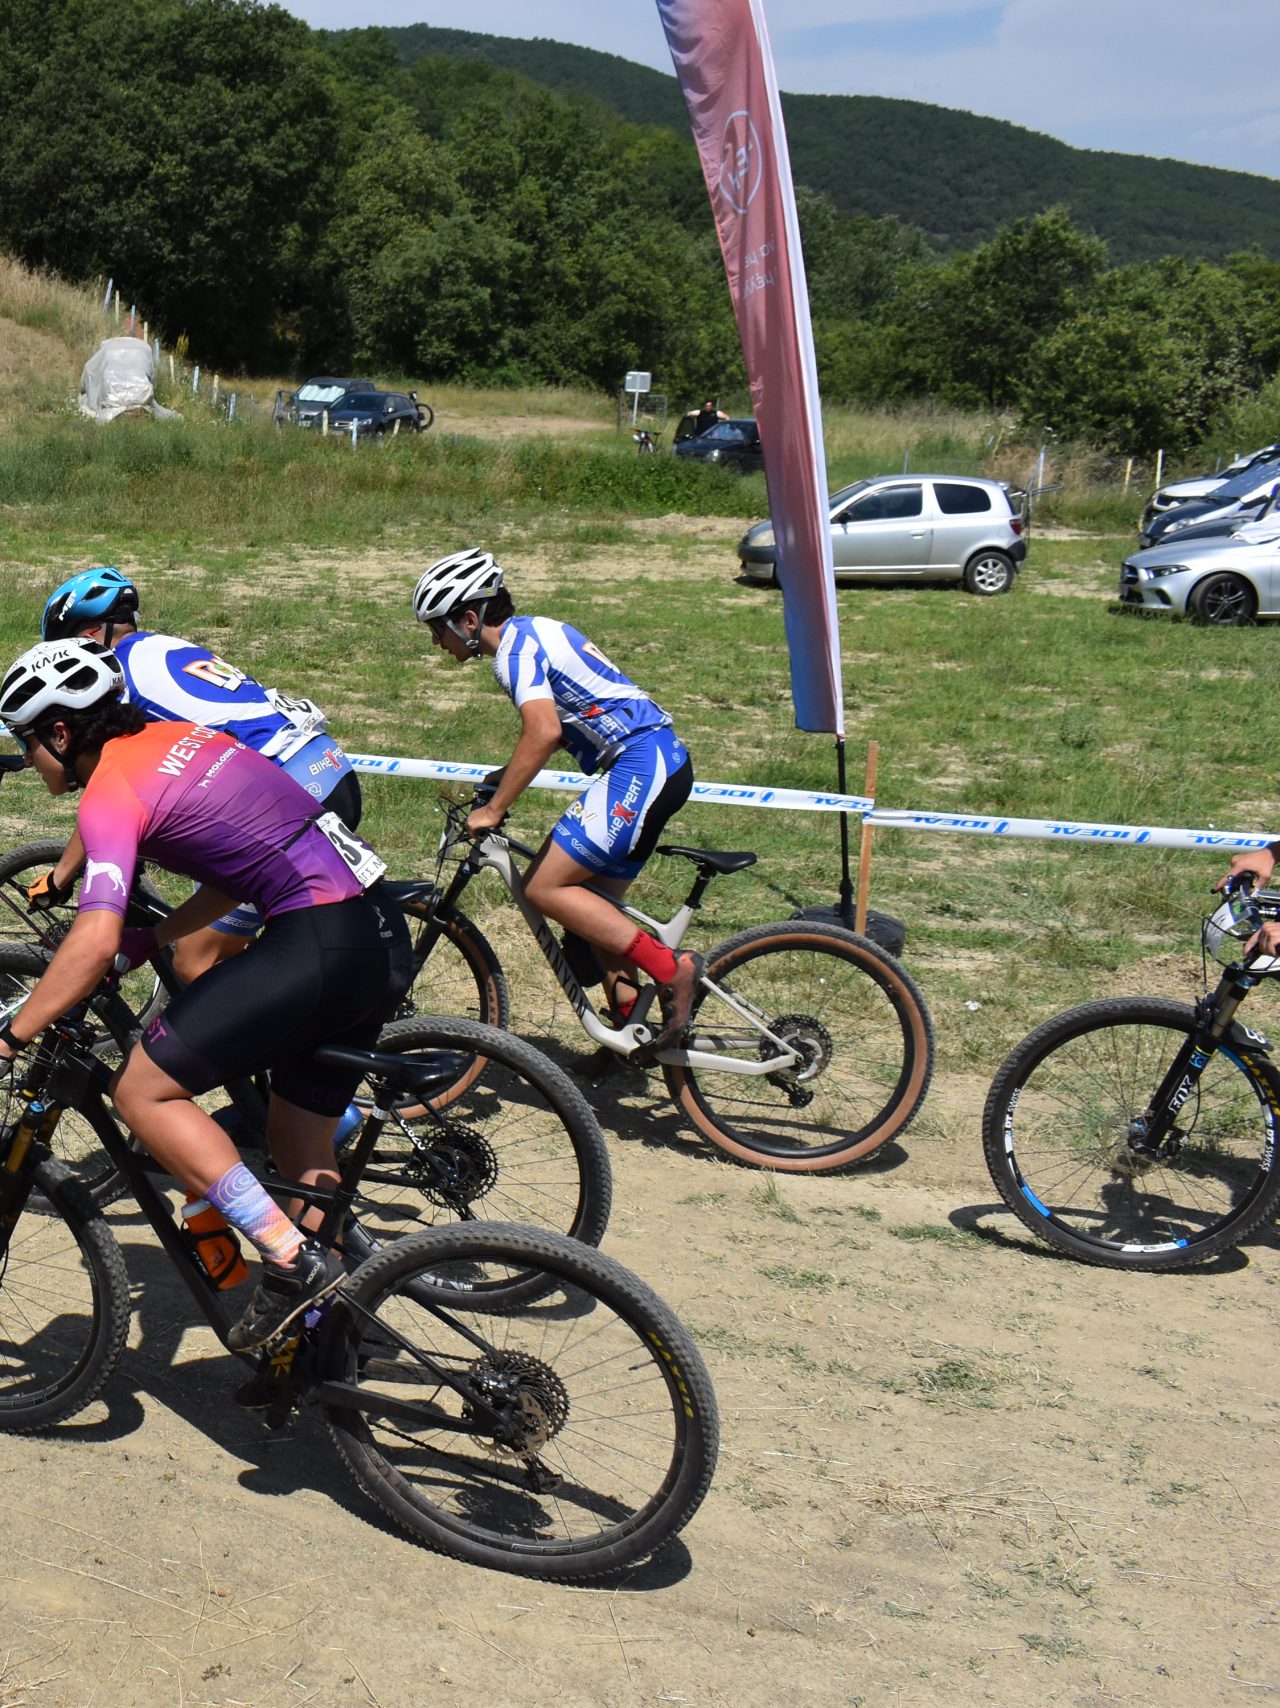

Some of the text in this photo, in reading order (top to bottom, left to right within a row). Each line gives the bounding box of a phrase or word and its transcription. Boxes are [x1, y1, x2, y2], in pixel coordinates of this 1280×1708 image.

[31, 650, 70, 673] KASK
[157, 736, 206, 778] WEST
[906, 813, 990, 829] IDEAL
[1043, 824, 1131, 840] IDEAL
[1005, 1087, 1021, 1128] DT SWISS
[1168, 1074, 1195, 1114] FOX
[1261, 1128, 1275, 1172] DT SWISS
[647, 1331, 694, 1418] MAXXIS
